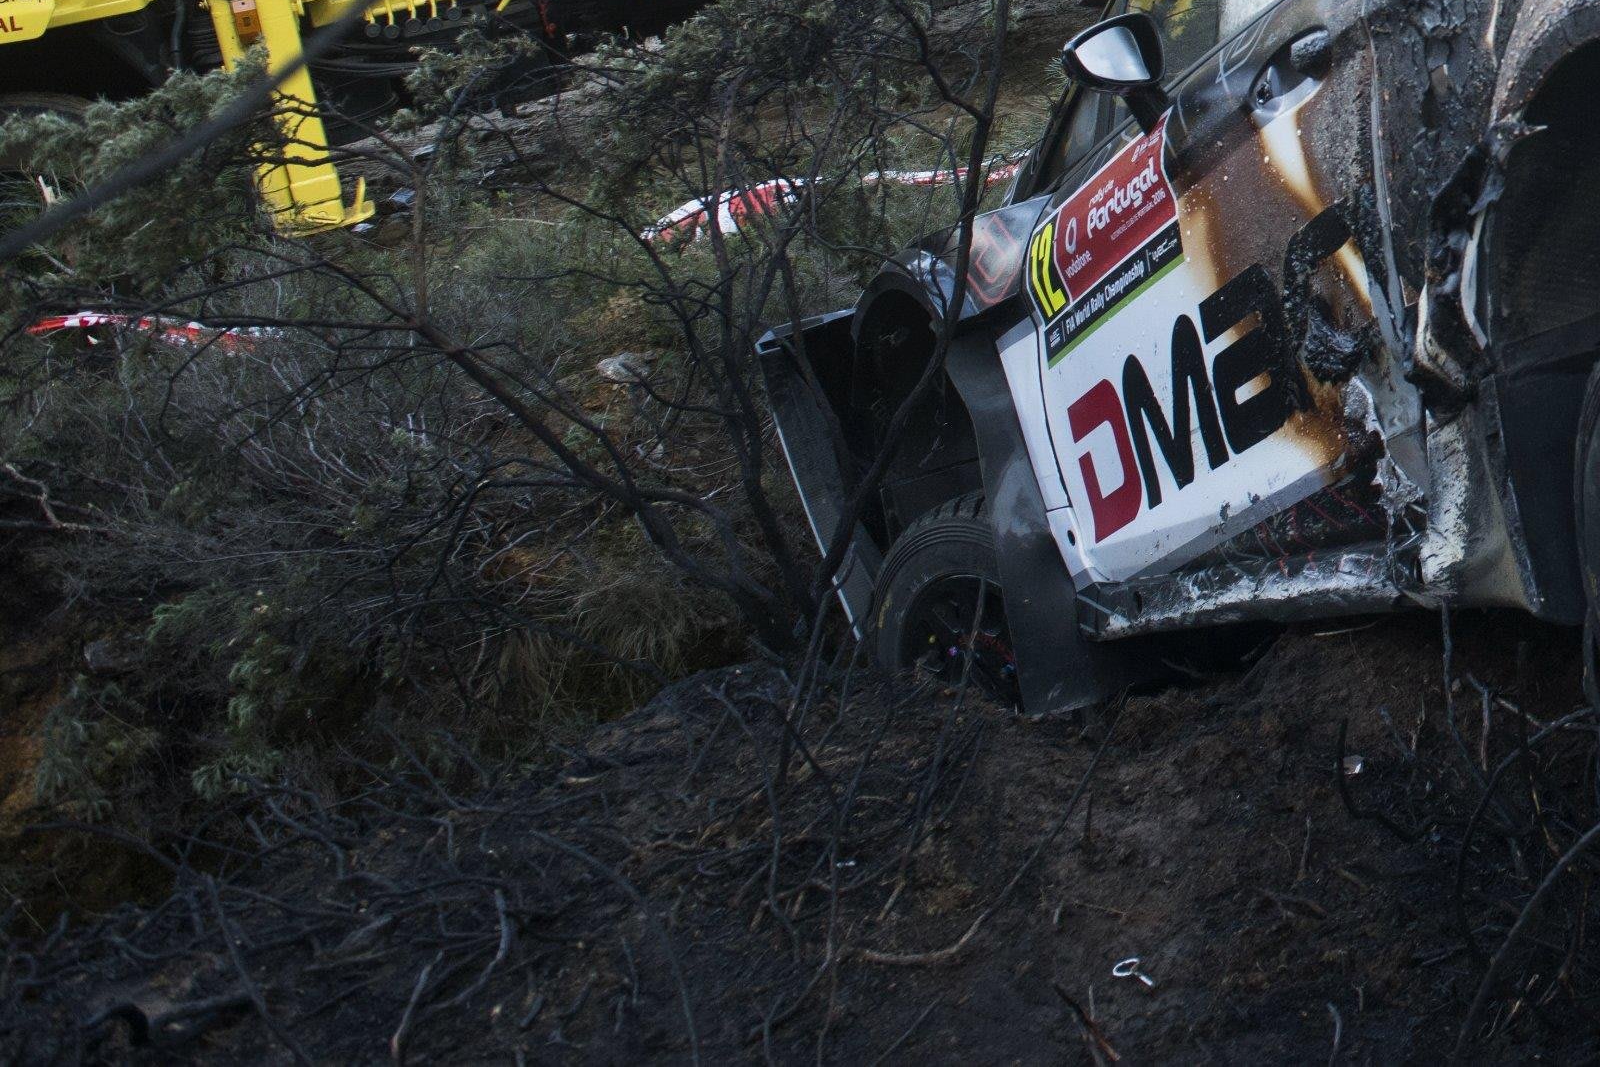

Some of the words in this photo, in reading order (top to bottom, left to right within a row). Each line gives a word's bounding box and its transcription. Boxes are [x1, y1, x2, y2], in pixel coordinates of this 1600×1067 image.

[1031, 222, 1067, 318] 12
[1065, 249, 1093, 279] vodafone
[1065, 315, 1076, 335] FIA
[1074, 302, 1091, 327] World
[1090, 292, 1105, 313] Rally
[1104, 259, 1145, 301] Championship
